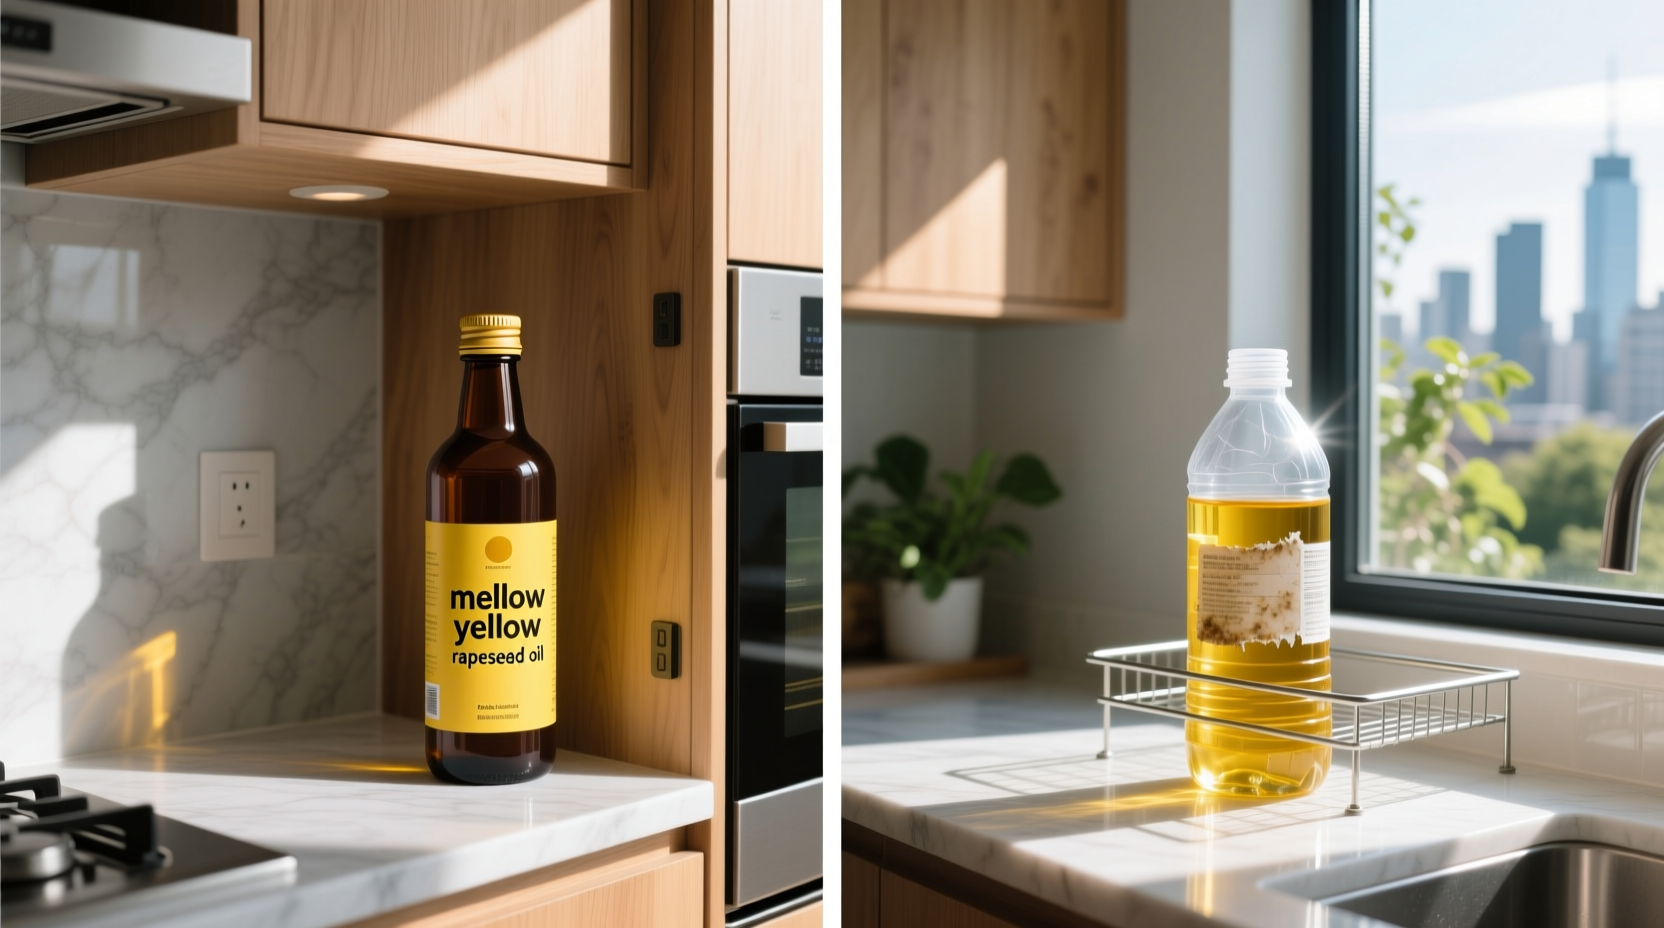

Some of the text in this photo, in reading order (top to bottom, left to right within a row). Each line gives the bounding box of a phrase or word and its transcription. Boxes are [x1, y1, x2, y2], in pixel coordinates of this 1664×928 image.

[451, 583, 545, 610] mellow
[453, 613, 541, 646] yellow
[529, 644, 544, 662] oil
